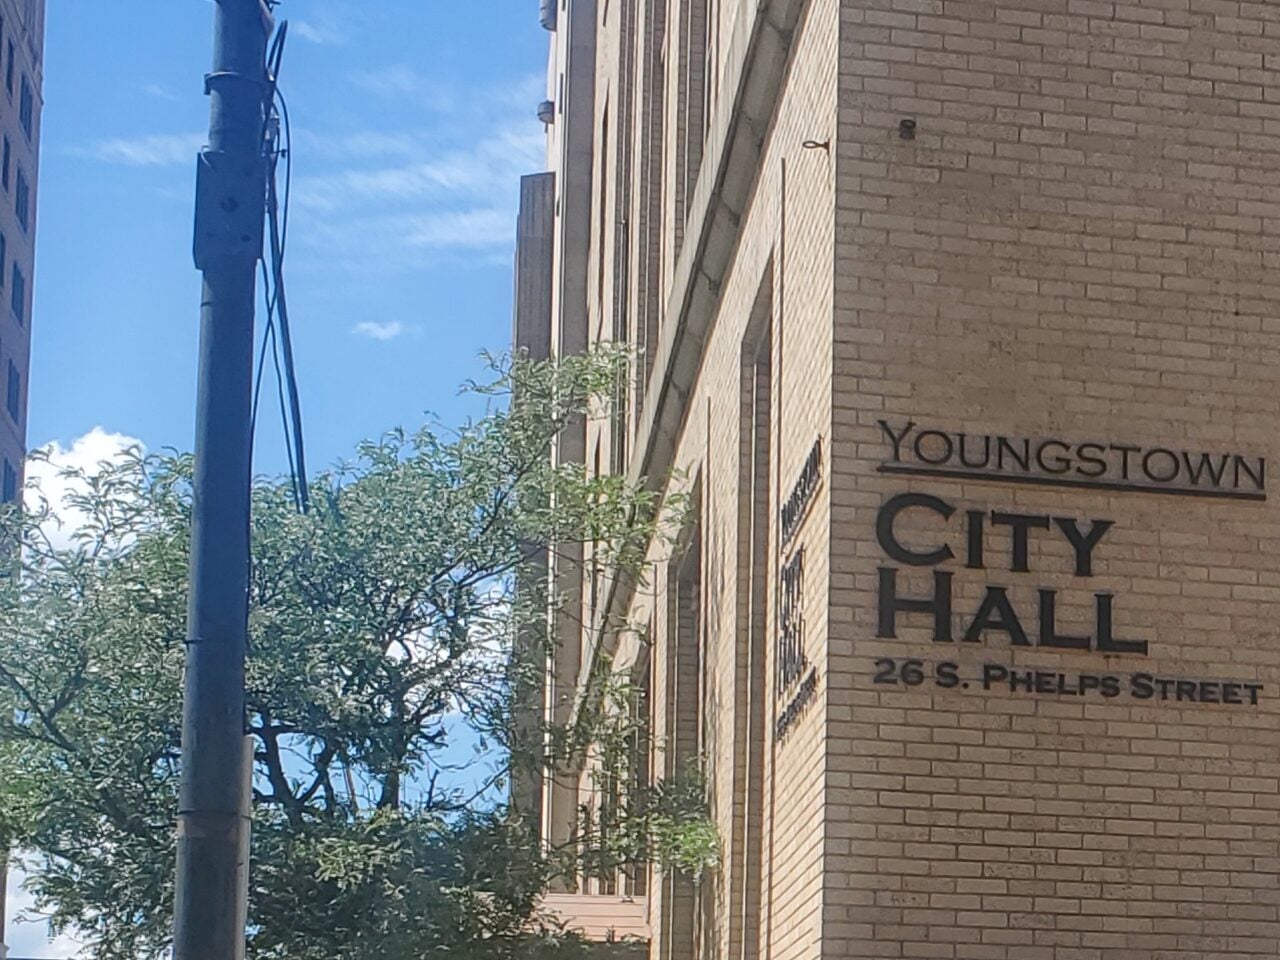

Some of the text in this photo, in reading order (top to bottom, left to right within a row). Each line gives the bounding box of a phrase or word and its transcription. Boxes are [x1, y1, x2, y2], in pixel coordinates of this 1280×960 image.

[877, 419, 1266, 491] YOUNGSTOWN
[876, 492, 1116, 577] CITY
[876, 566, 1148, 656] HALL
[873, 658, 1264, 706] 26 S. PHELPS STREET
